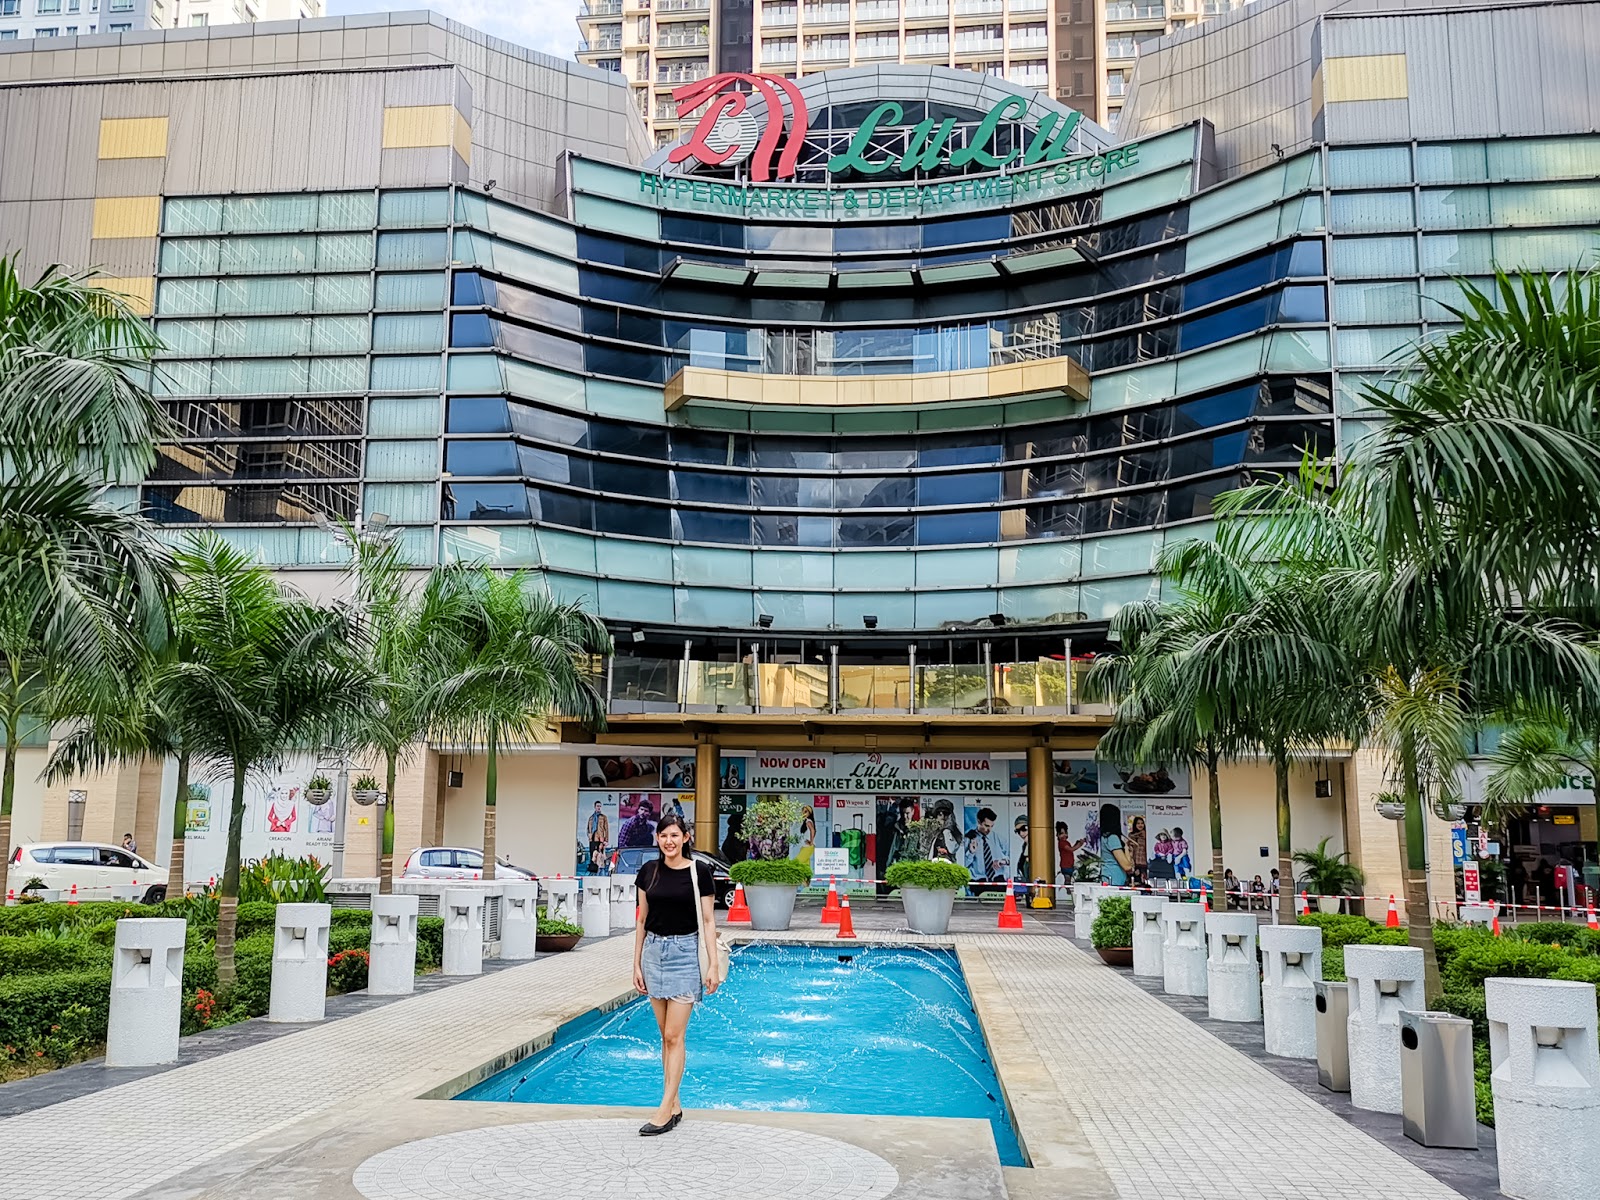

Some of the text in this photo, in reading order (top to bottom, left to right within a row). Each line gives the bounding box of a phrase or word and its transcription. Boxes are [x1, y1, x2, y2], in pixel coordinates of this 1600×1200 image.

[827, 95, 1081, 173] LuLu
[640, 143, 1139, 210] HYPERMARKET & DEPARTMENT STORE
[760, 758, 826, 769] NOW OPEN
[849, 762, 900, 779] LuLu
[909, 759, 990, 771] KINI DIBUKA
[752, 777, 1001, 792] HYPERMARKET & DEPARTMENT STORE
[1559, 775, 1592, 790] NCE
